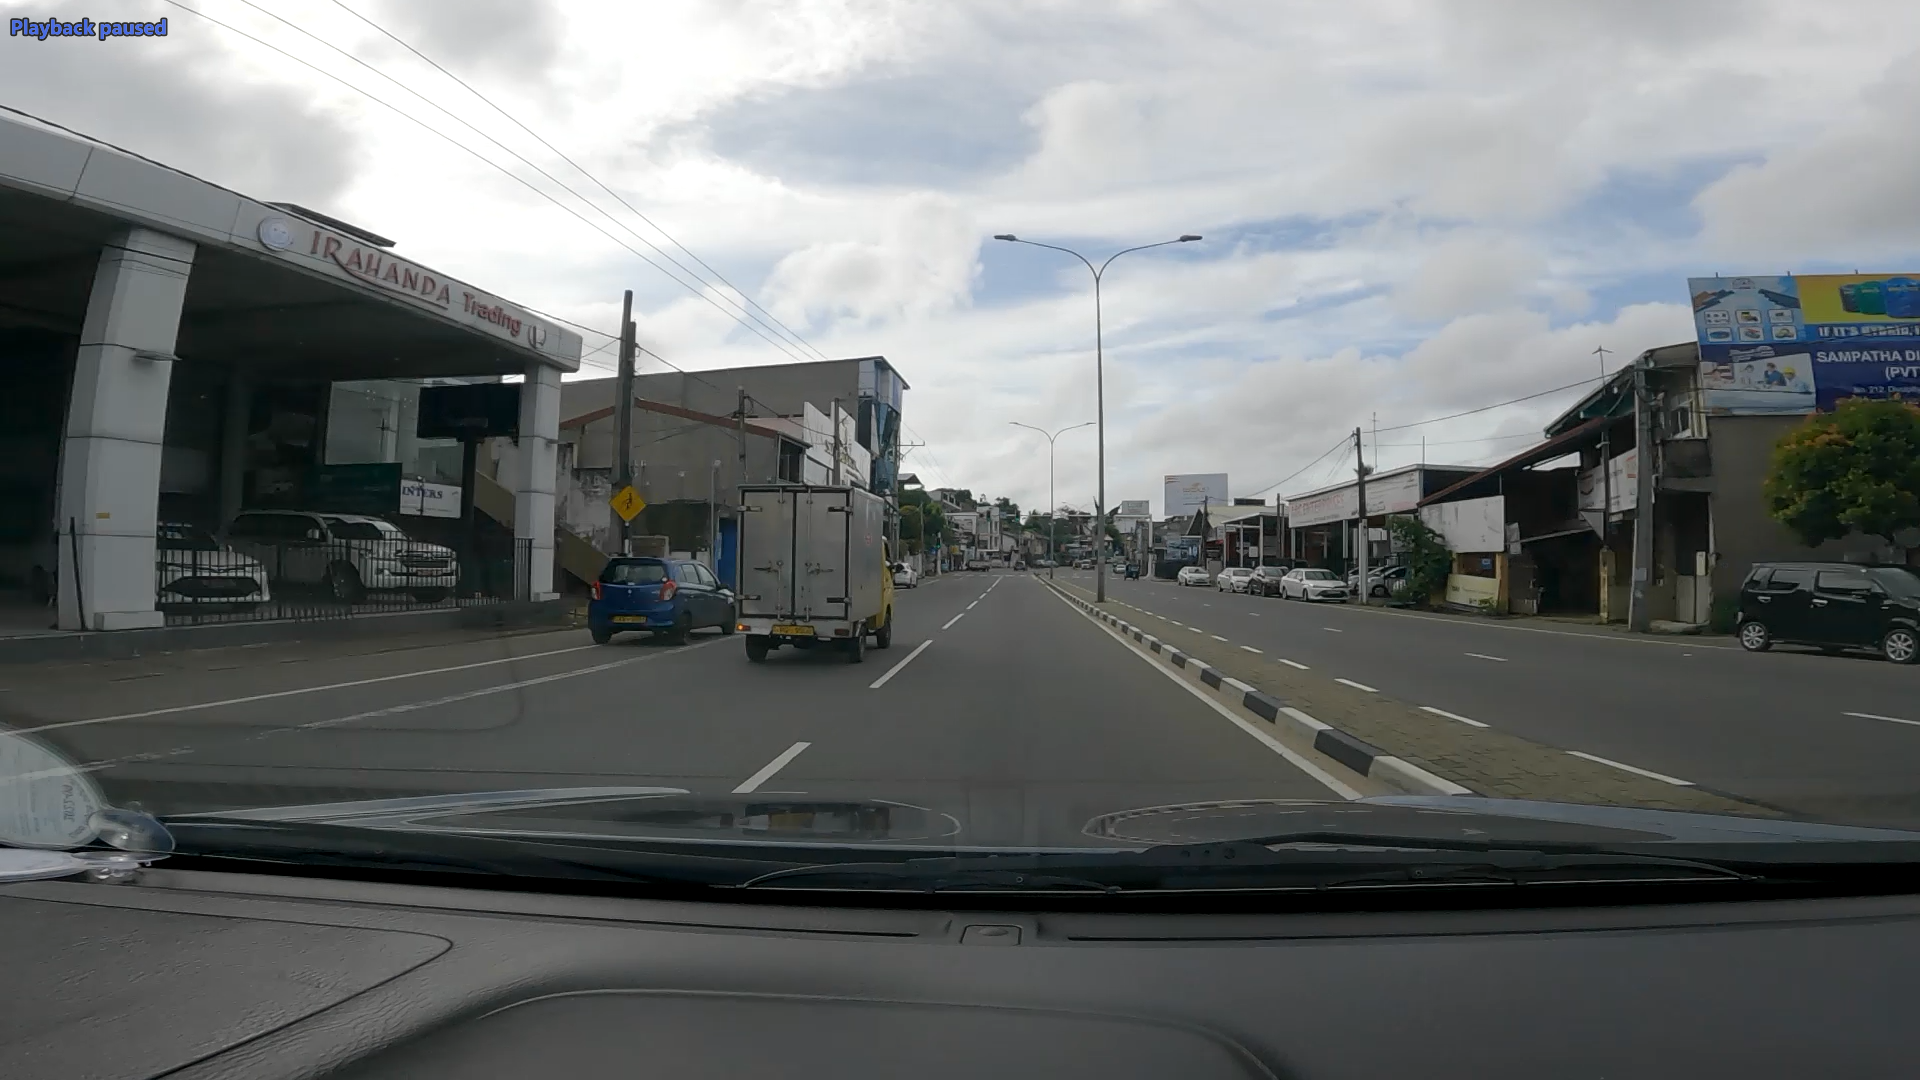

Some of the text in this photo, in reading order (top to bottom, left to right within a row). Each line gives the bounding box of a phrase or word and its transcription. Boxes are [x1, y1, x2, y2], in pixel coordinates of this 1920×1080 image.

[310, 230, 523, 337] IRAHANDA Trading
[1816, 351, 1902, 363] SAMPATHA
